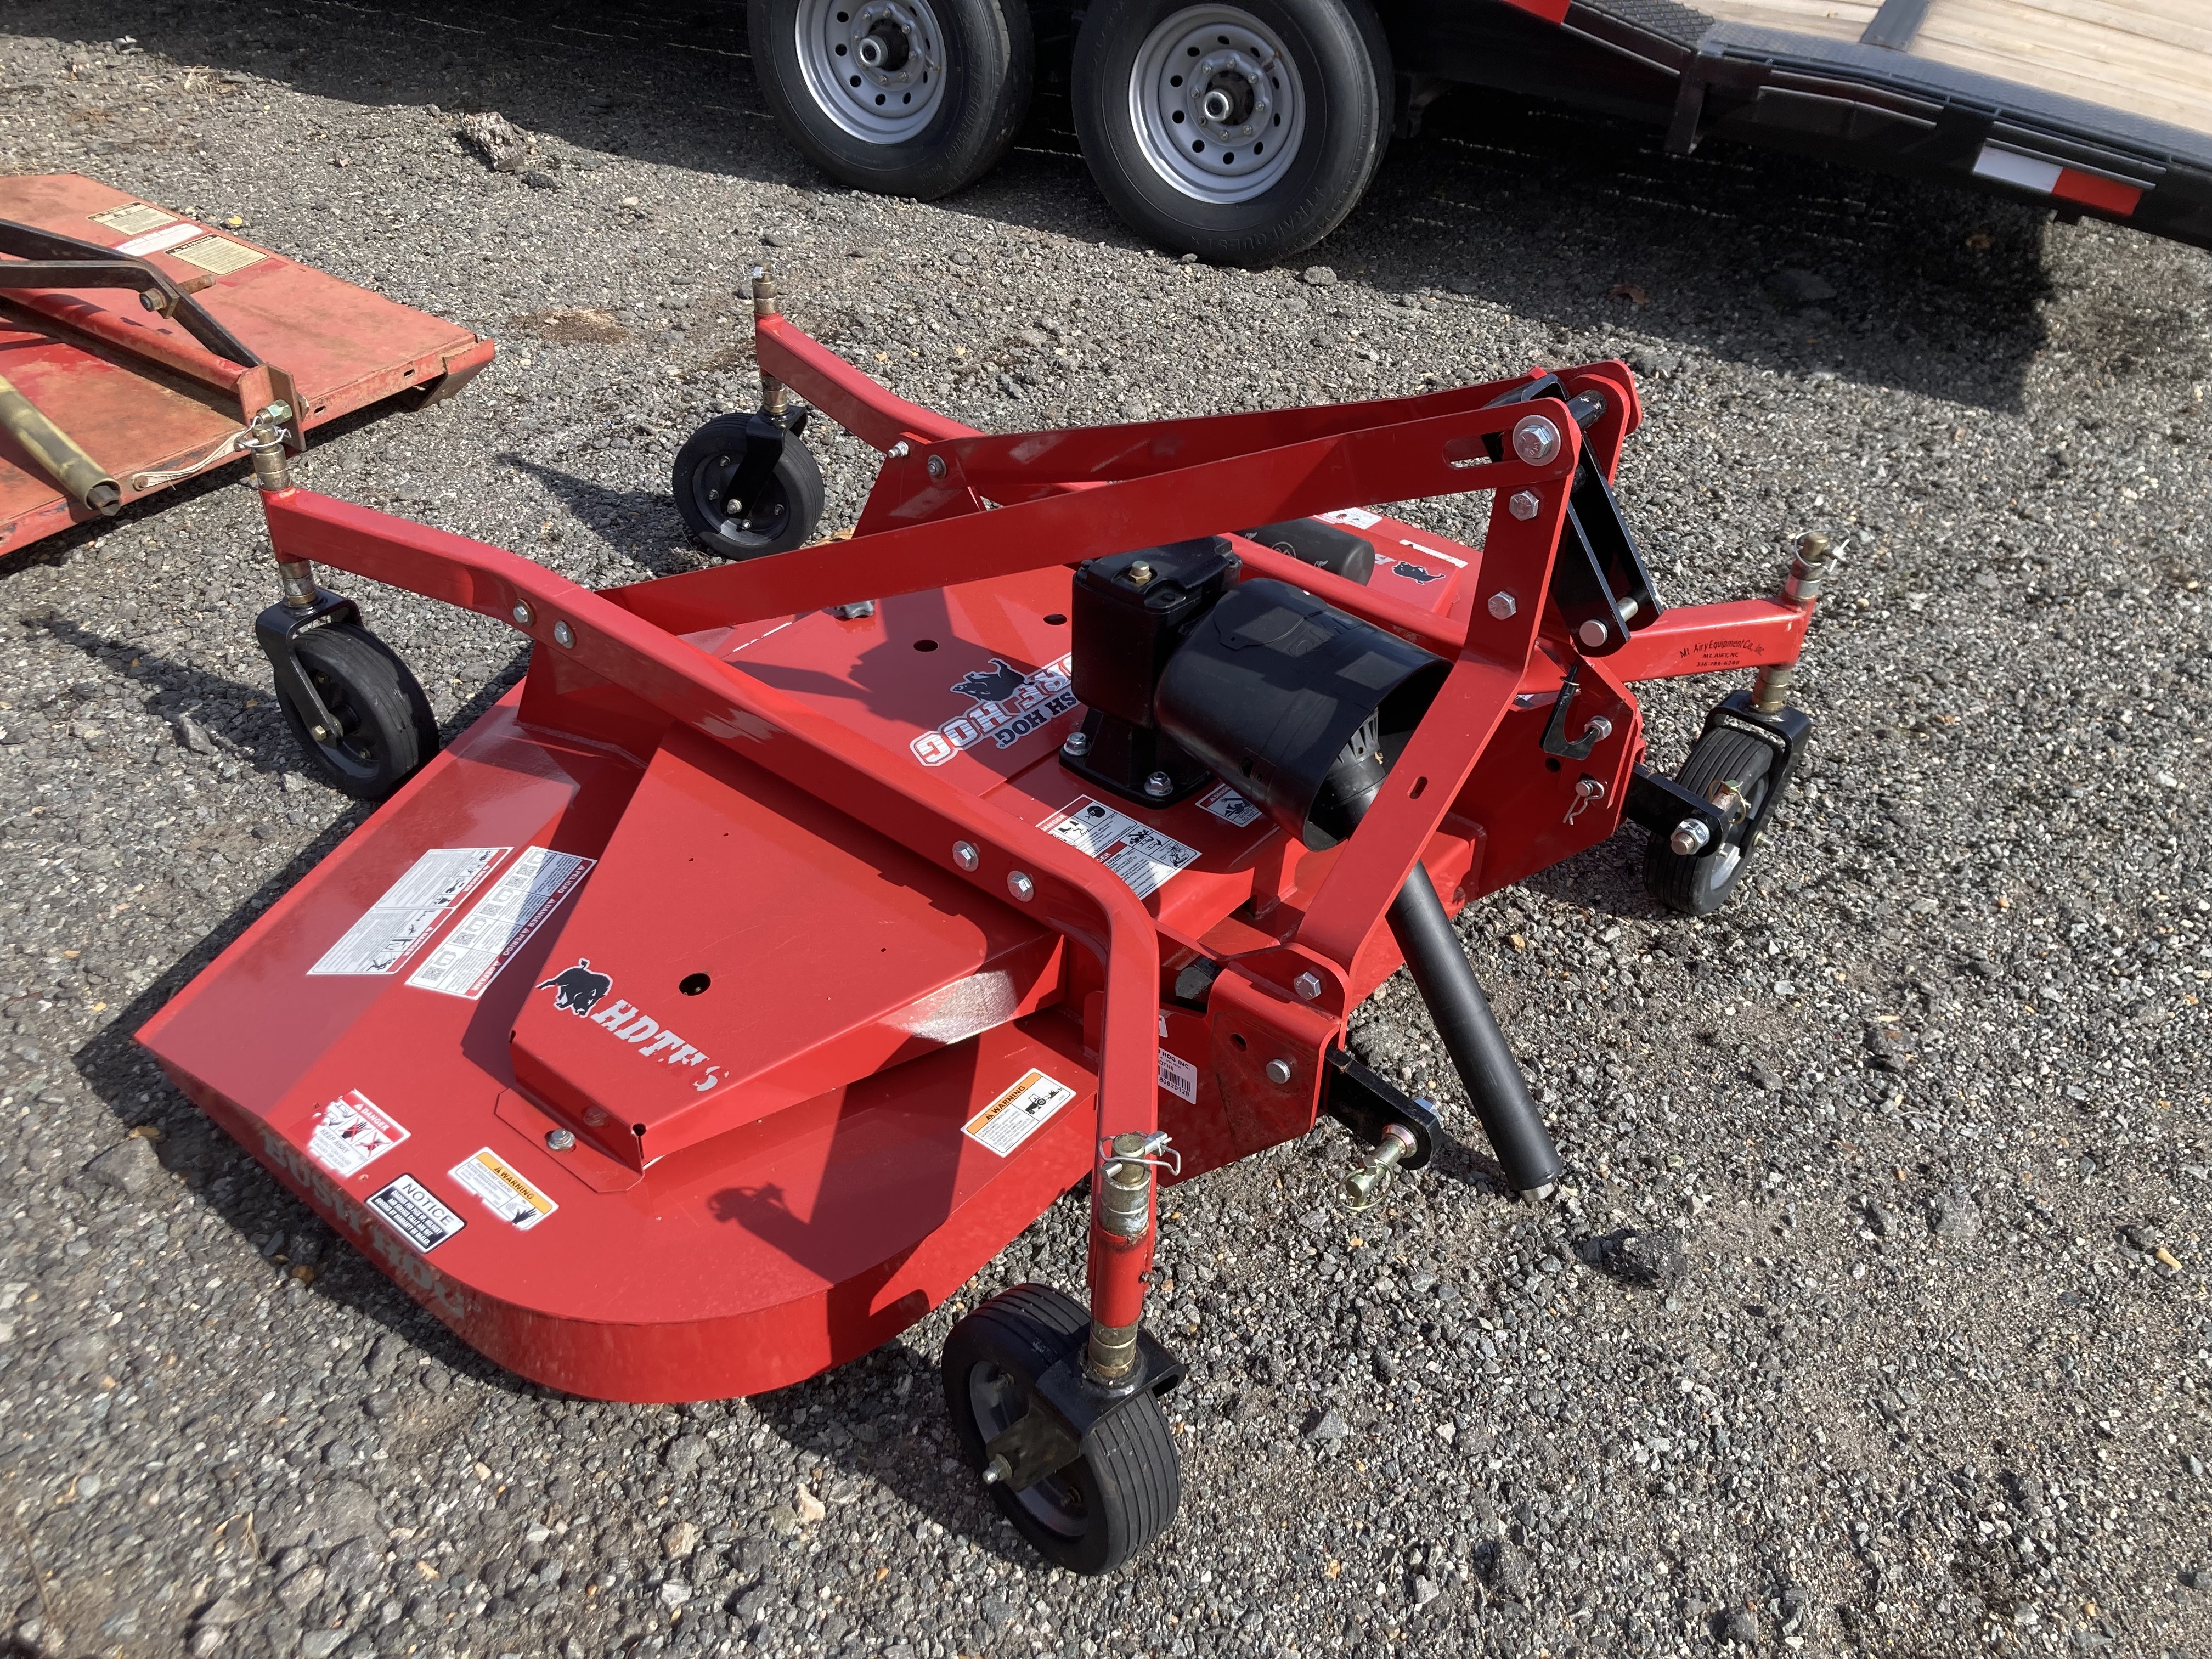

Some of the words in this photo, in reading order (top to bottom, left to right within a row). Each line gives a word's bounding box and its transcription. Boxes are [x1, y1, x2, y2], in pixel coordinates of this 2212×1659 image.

[1709, 637, 1745, 649] Equipment
[915, 701, 1012, 763] HOG
[995, 708, 1048, 745] HOG
[1215, 786, 1230, 799] DANGE
[556, 868, 582, 895] PELIGRO
[527, 902, 551, 929] DANGER
[403, 931, 429, 957] DANGER
[502, 932, 526, 958] PERIGO
[471, 965, 496, 993] GEFAHR
[1162, 1051, 1176, 1062] HOG
[991, 1085, 1025, 1114] WARNING
[362, 1108, 390, 1131] DANGER
[320, 1128, 336, 1142] KEEP
[332, 1140, 351, 1154] AWAY
[497, 1180, 513, 1193] HAZARD
[500, 1171, 535, 1200] WARNING
[375, 1197, 393, 1212] COVERED
[393, 1214, 414, 1231] WARRANTY
[388, 1198, 398, 1206] AND
[394, 1204, 410, 1217] SERVICE
[407, 1215, 420, 1226] CALLS
[417, 1223, 426, 1231] ARE
[423, 1228, 433, 1237] NOT
[391, 1190, 408, 1205] CHARGES
[405, 1202, 414, 1210] FOR
[411, 1207, 422, 1217] PICK
[424, 1220, 443, 1235] DELIVERY
[402, 1182, 454, 1226] NOTICE
[258, 1128, 363, 1236] BUSH
[373, 1229, 466, 1320] HOG
